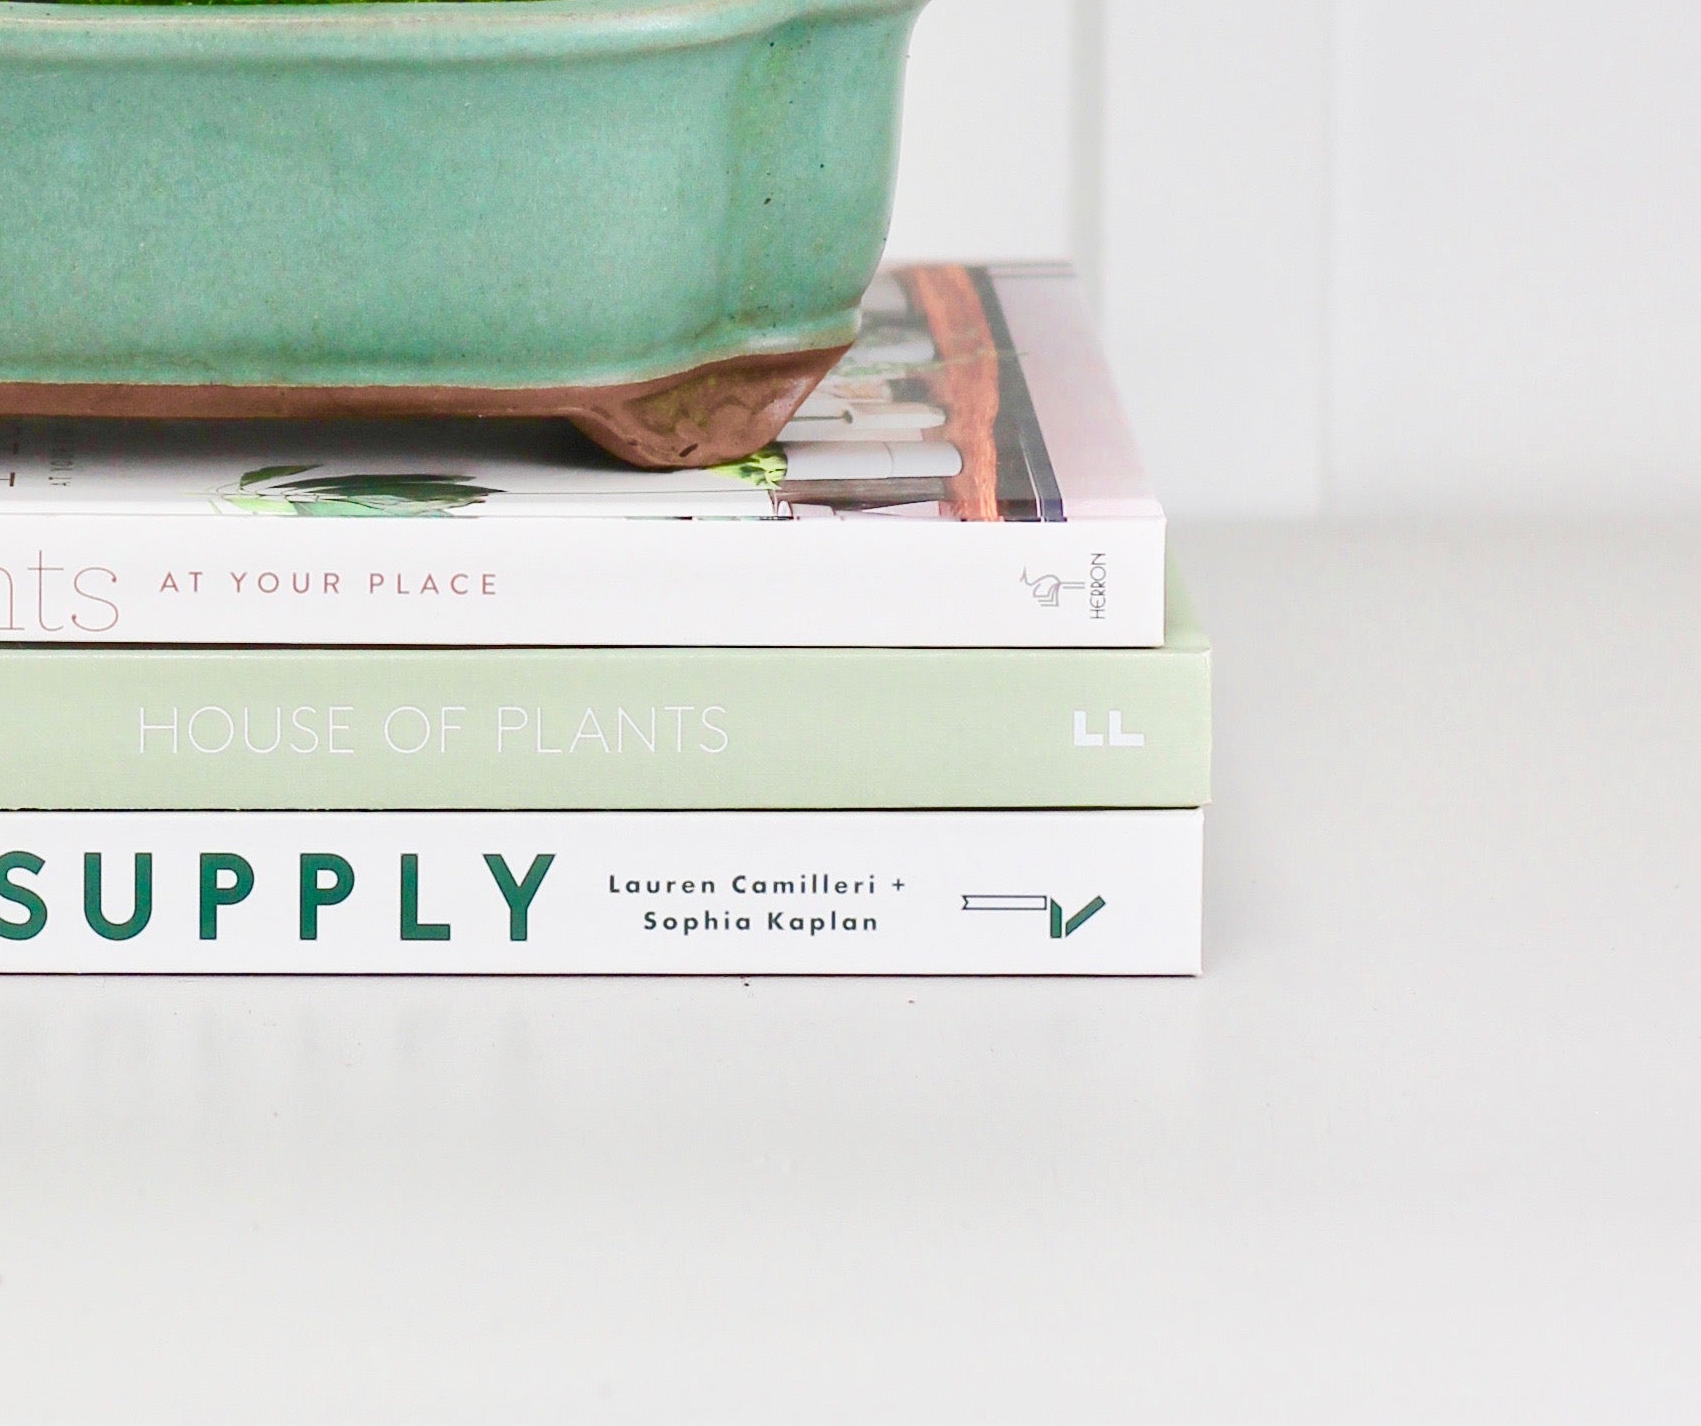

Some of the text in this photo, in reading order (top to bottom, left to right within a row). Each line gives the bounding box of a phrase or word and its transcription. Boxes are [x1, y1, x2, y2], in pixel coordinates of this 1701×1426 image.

[159, 571, 203, 593] AT
[231, 571, 340, 594] YOUR
[369, 572, 496, 595] PLACE
[1089, 552, 1107, 620] HERRON
[138, 705, 730, 754] HOUSE OF PLANTS
[609, 874, 715, 895] Lauren
[731, 873, 875, 895] Camilleri
[643, 909, 877, 936] Sophia Kaplan
